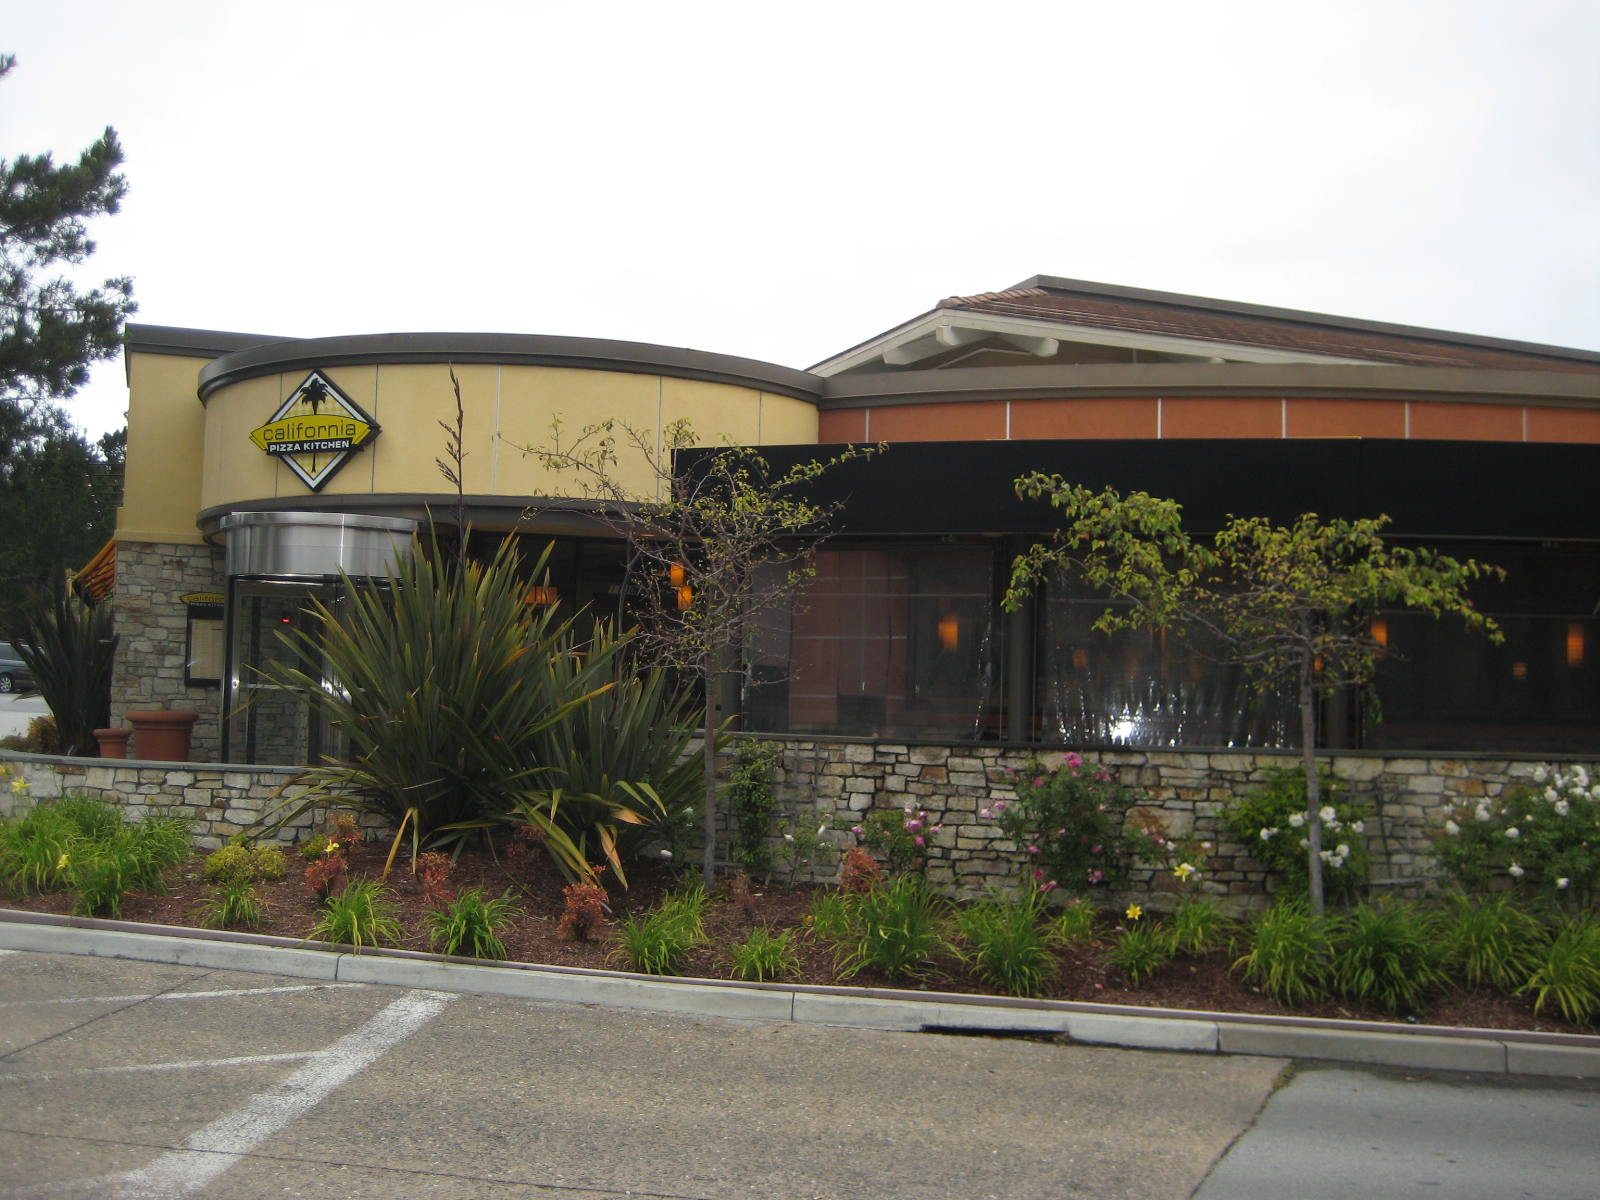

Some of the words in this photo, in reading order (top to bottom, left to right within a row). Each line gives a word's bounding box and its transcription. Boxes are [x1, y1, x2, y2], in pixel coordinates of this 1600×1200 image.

[263, 420, 357, 441] california
[269, 443, 301, 453] PIZZA
[303, 440, 350, 451] KITCHEN
